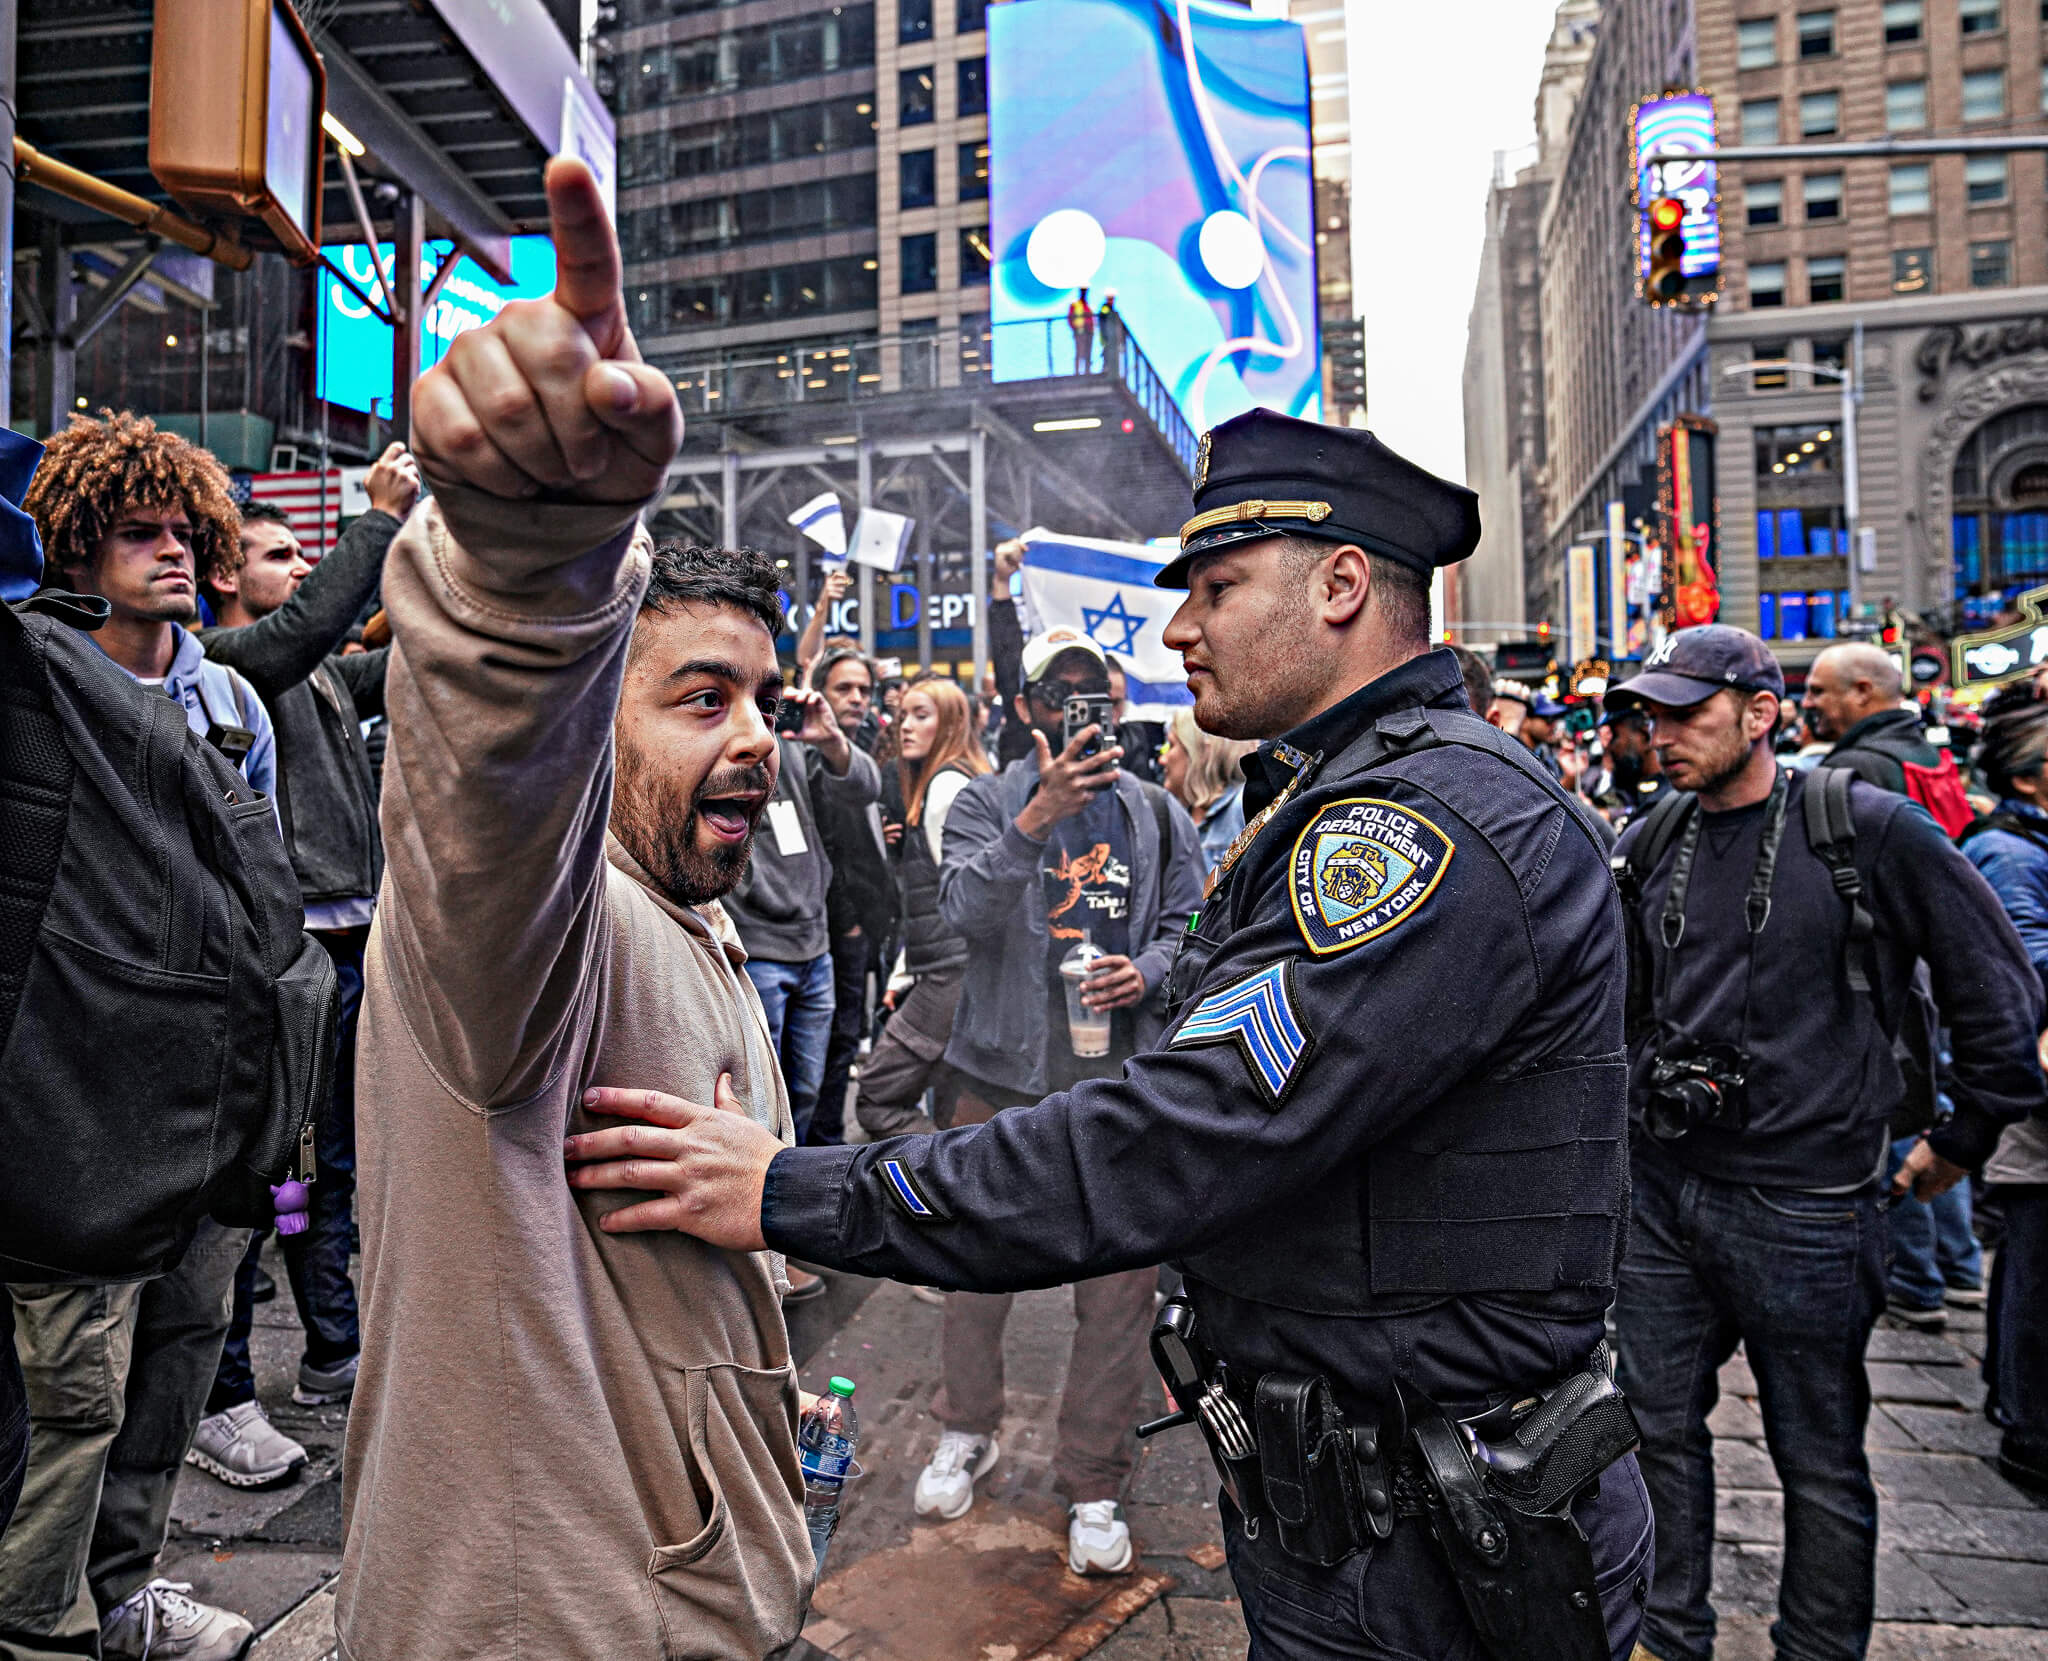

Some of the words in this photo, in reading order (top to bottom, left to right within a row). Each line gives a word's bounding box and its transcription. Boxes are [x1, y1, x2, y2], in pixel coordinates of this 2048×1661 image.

[1349, 806, 1418, 838] POLICE
[1315, 819, 1433, 870] DEPARTMENT
[1297, 849, 1312, 888] CITY
[1300, 891, 1317, 917] OF
[1378, 878, 1426, 918] YORK
[1338, 913, 1379, 939] NEW
